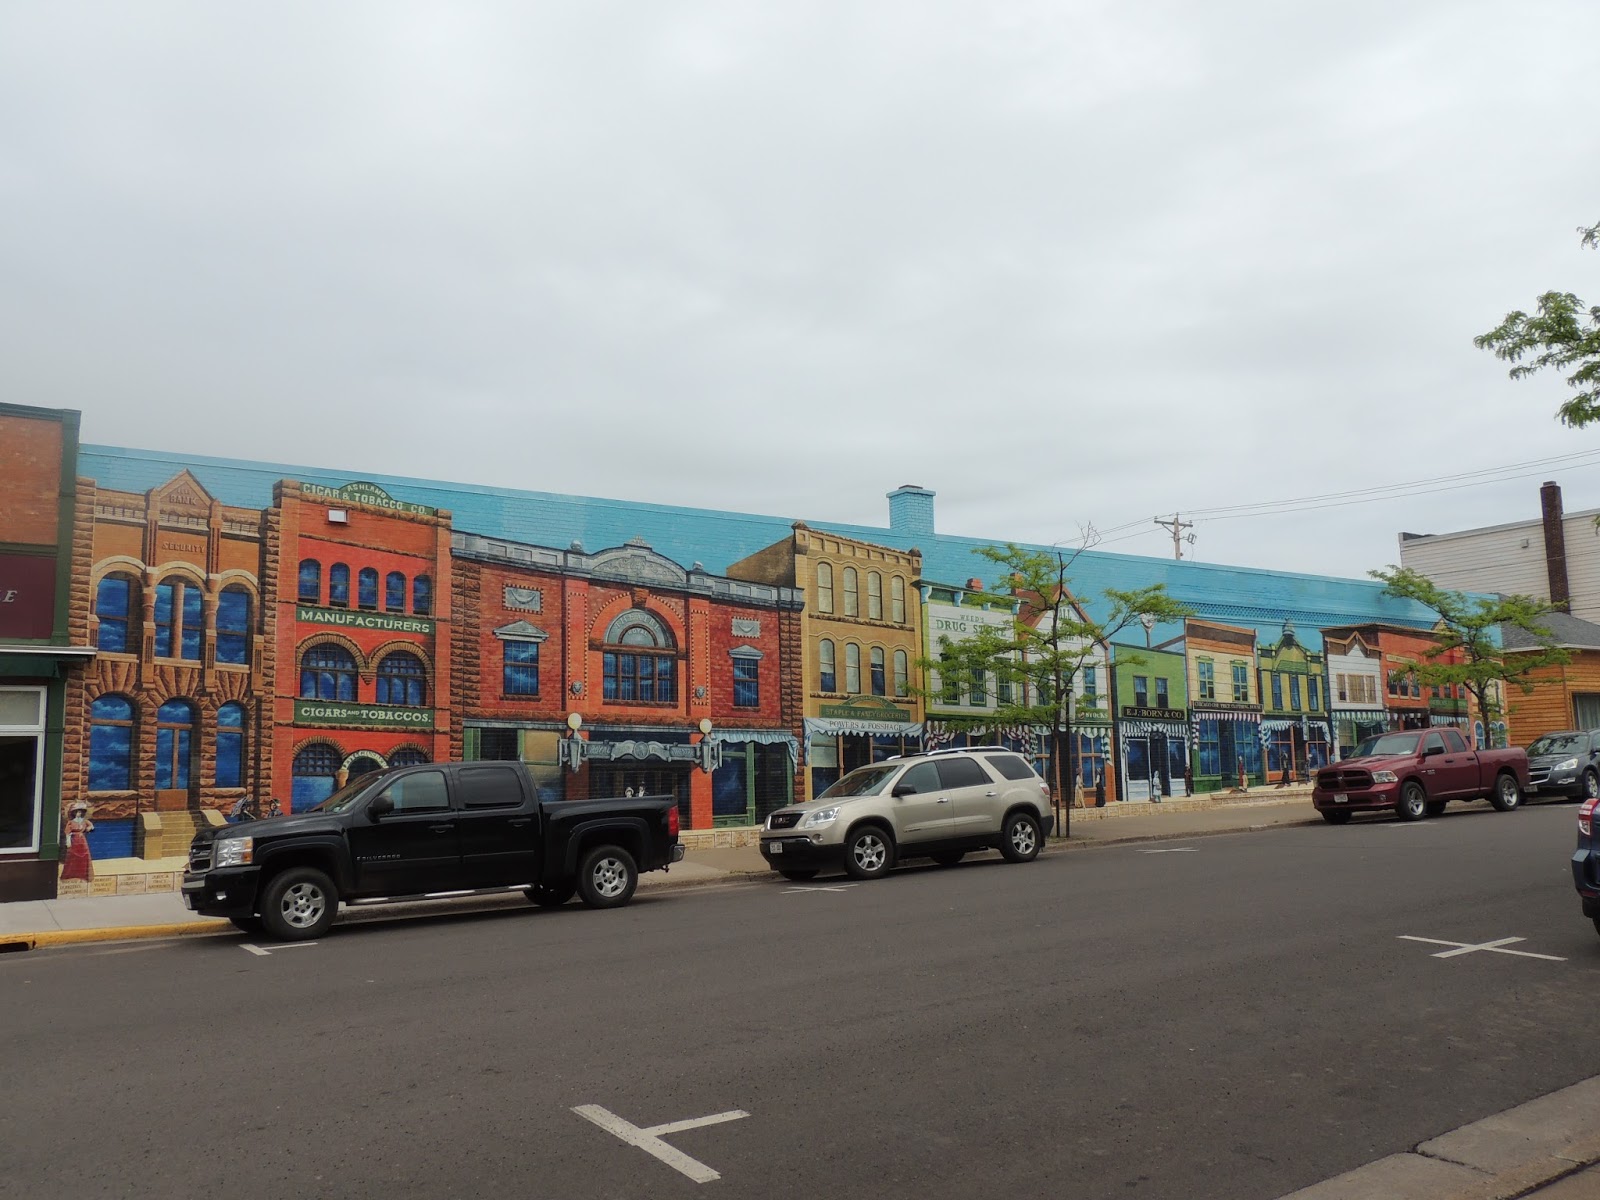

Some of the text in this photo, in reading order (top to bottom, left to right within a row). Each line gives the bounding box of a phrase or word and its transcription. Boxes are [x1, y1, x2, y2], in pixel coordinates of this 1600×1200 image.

[347, 483, 387, 498] ASHLAND
[169, 495, 197, 506] BANK
[303, 483, 428, 515] CIGAR & TOBACCO CO.
[162, 541, 205, 553] SECURITY
[301, 610, 430, 633] MANUFACTURERS
[936, 619, 966, 632] DRUG
[301, 707, 347, 718] CIGARS
[361, 710, 432, 723] TOBACCOS.
[826, 708, 849, 716] STAPLE
[1141, 709, 1163, 718] BORN
[1171, 711, 1184, 719] CO.
[829, 720, 859, 729] POWERS
[868, 723, 903, 731] FOSSHAGE
